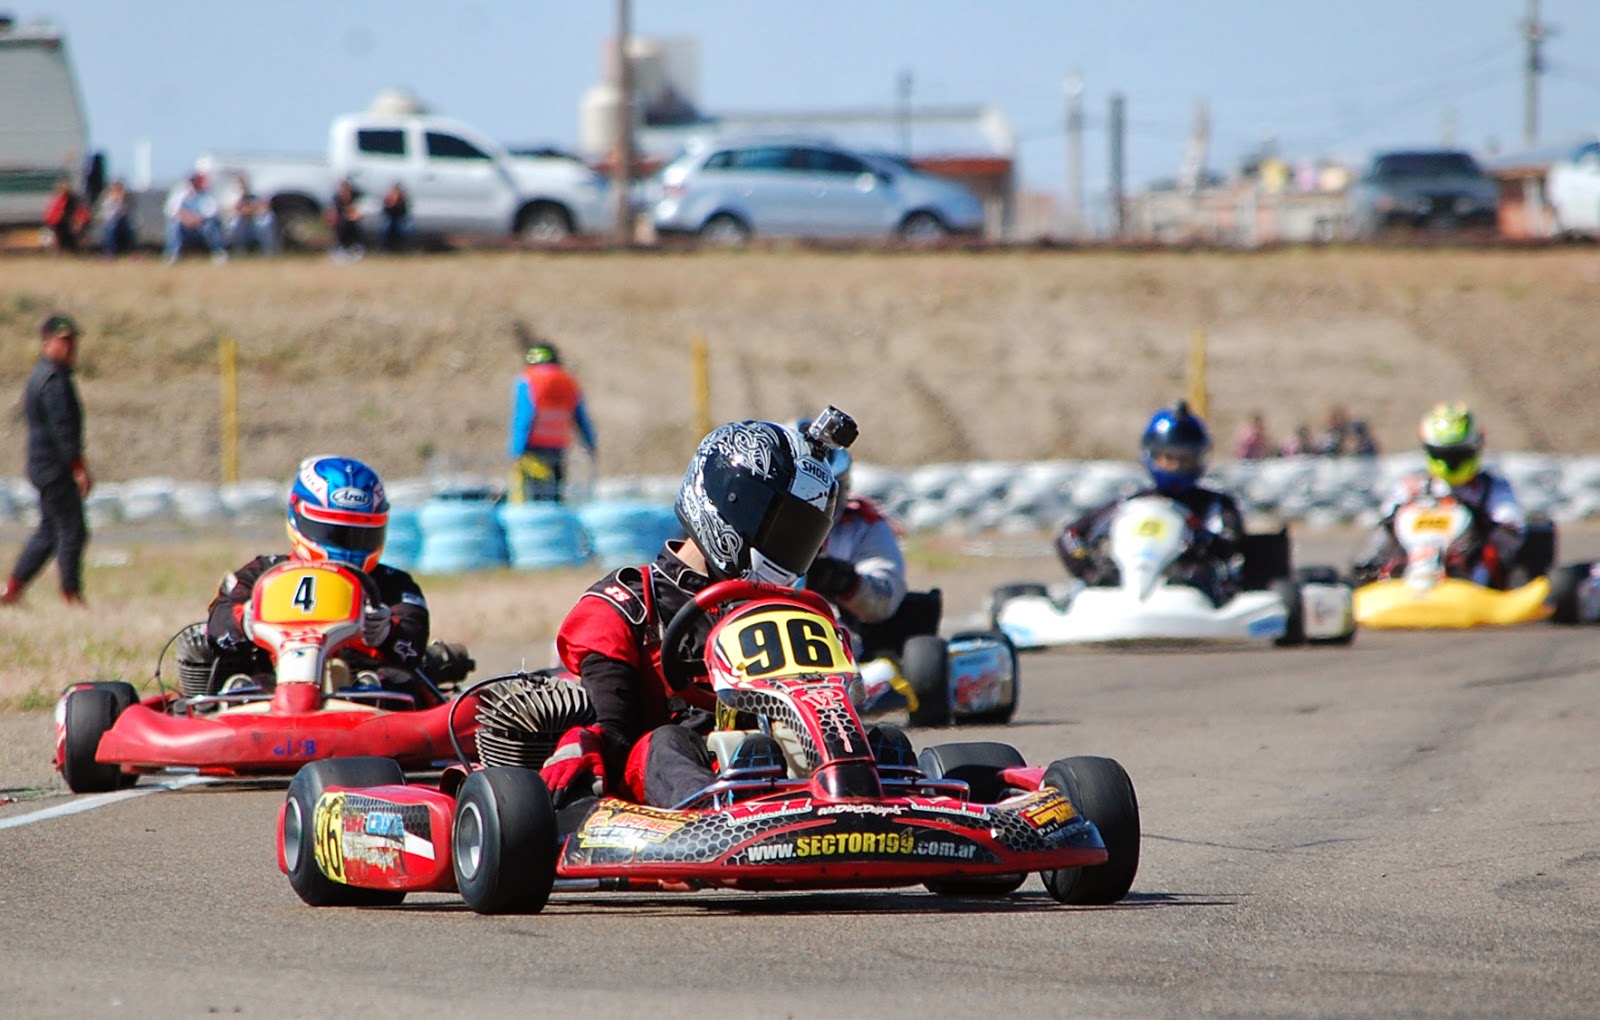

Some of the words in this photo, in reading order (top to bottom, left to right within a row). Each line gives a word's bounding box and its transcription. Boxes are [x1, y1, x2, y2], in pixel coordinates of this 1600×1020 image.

[801, 460, 829, 482] SHOEI
[292, 575, 316, 613] 4
[739, 618, 834, 675] 96
[747, 832, 977, 862] www.SECTOR199.com.ar
